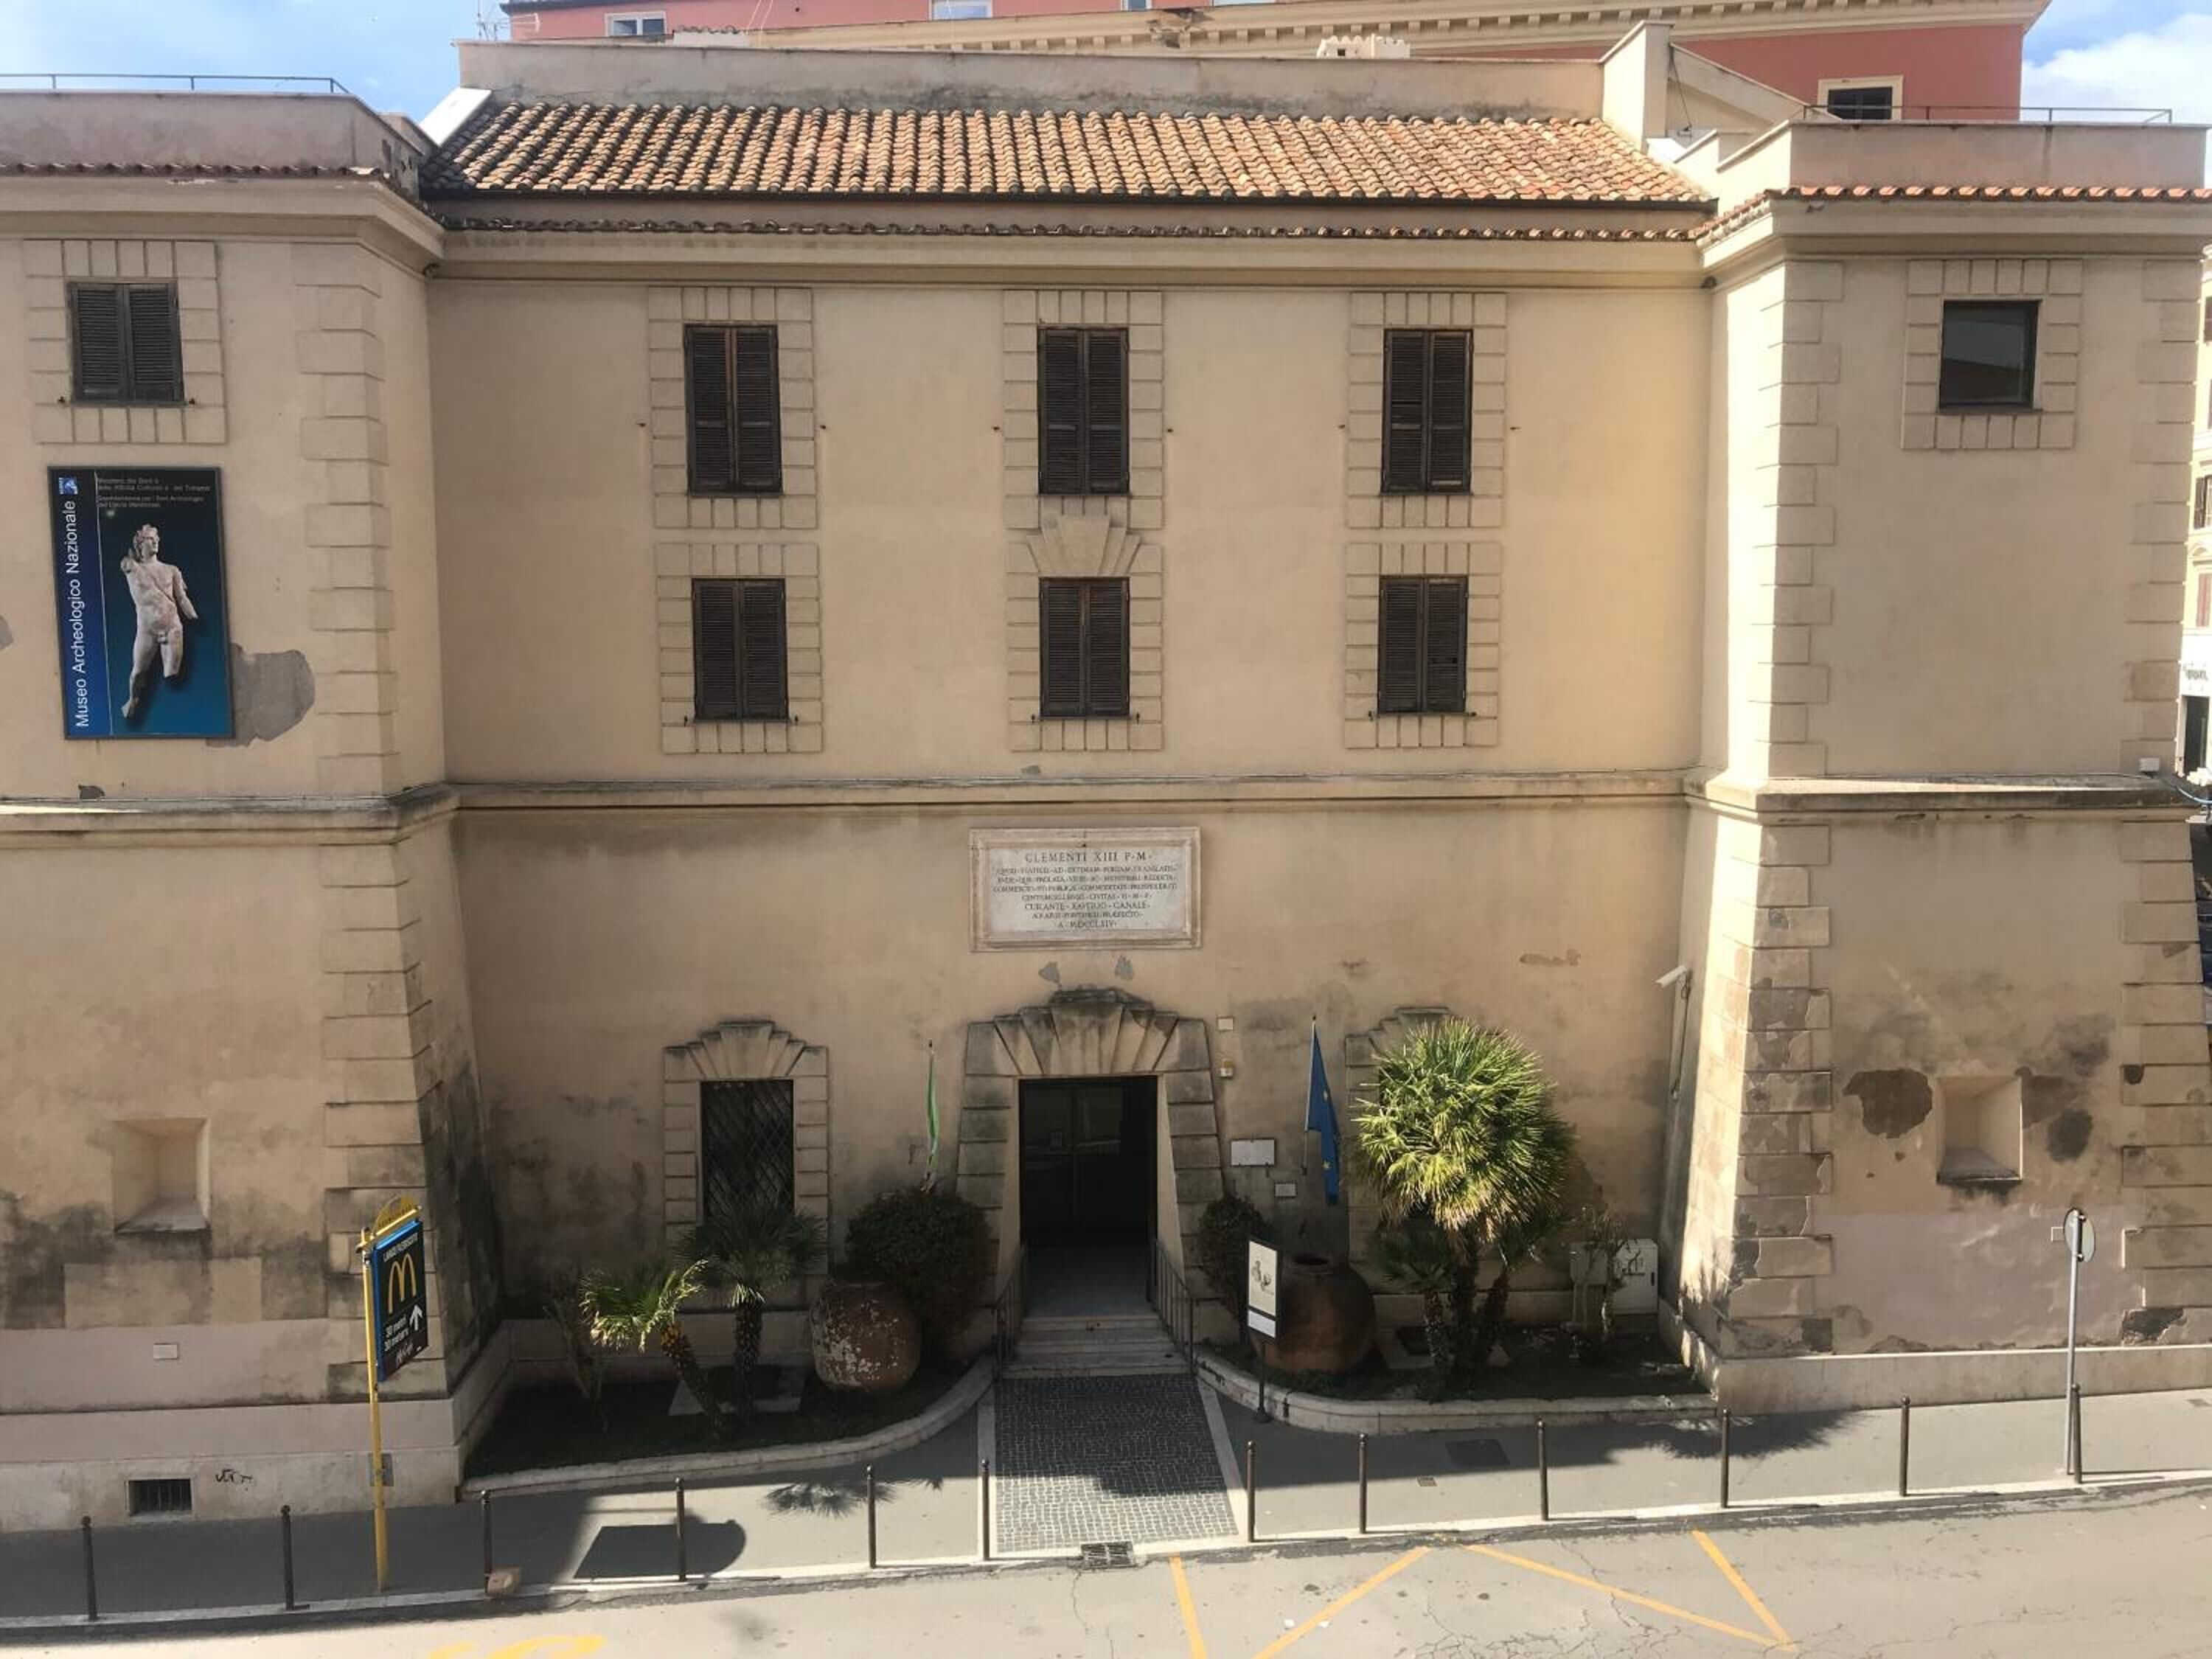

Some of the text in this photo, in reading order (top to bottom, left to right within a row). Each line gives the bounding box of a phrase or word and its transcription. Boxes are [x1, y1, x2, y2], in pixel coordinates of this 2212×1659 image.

[63, 500, 89, 728] Museo Archeologico Nazionale
[1024, 852, 1087, 863] CLEMENTI
[1095, 852, 1117, 862] XIII
